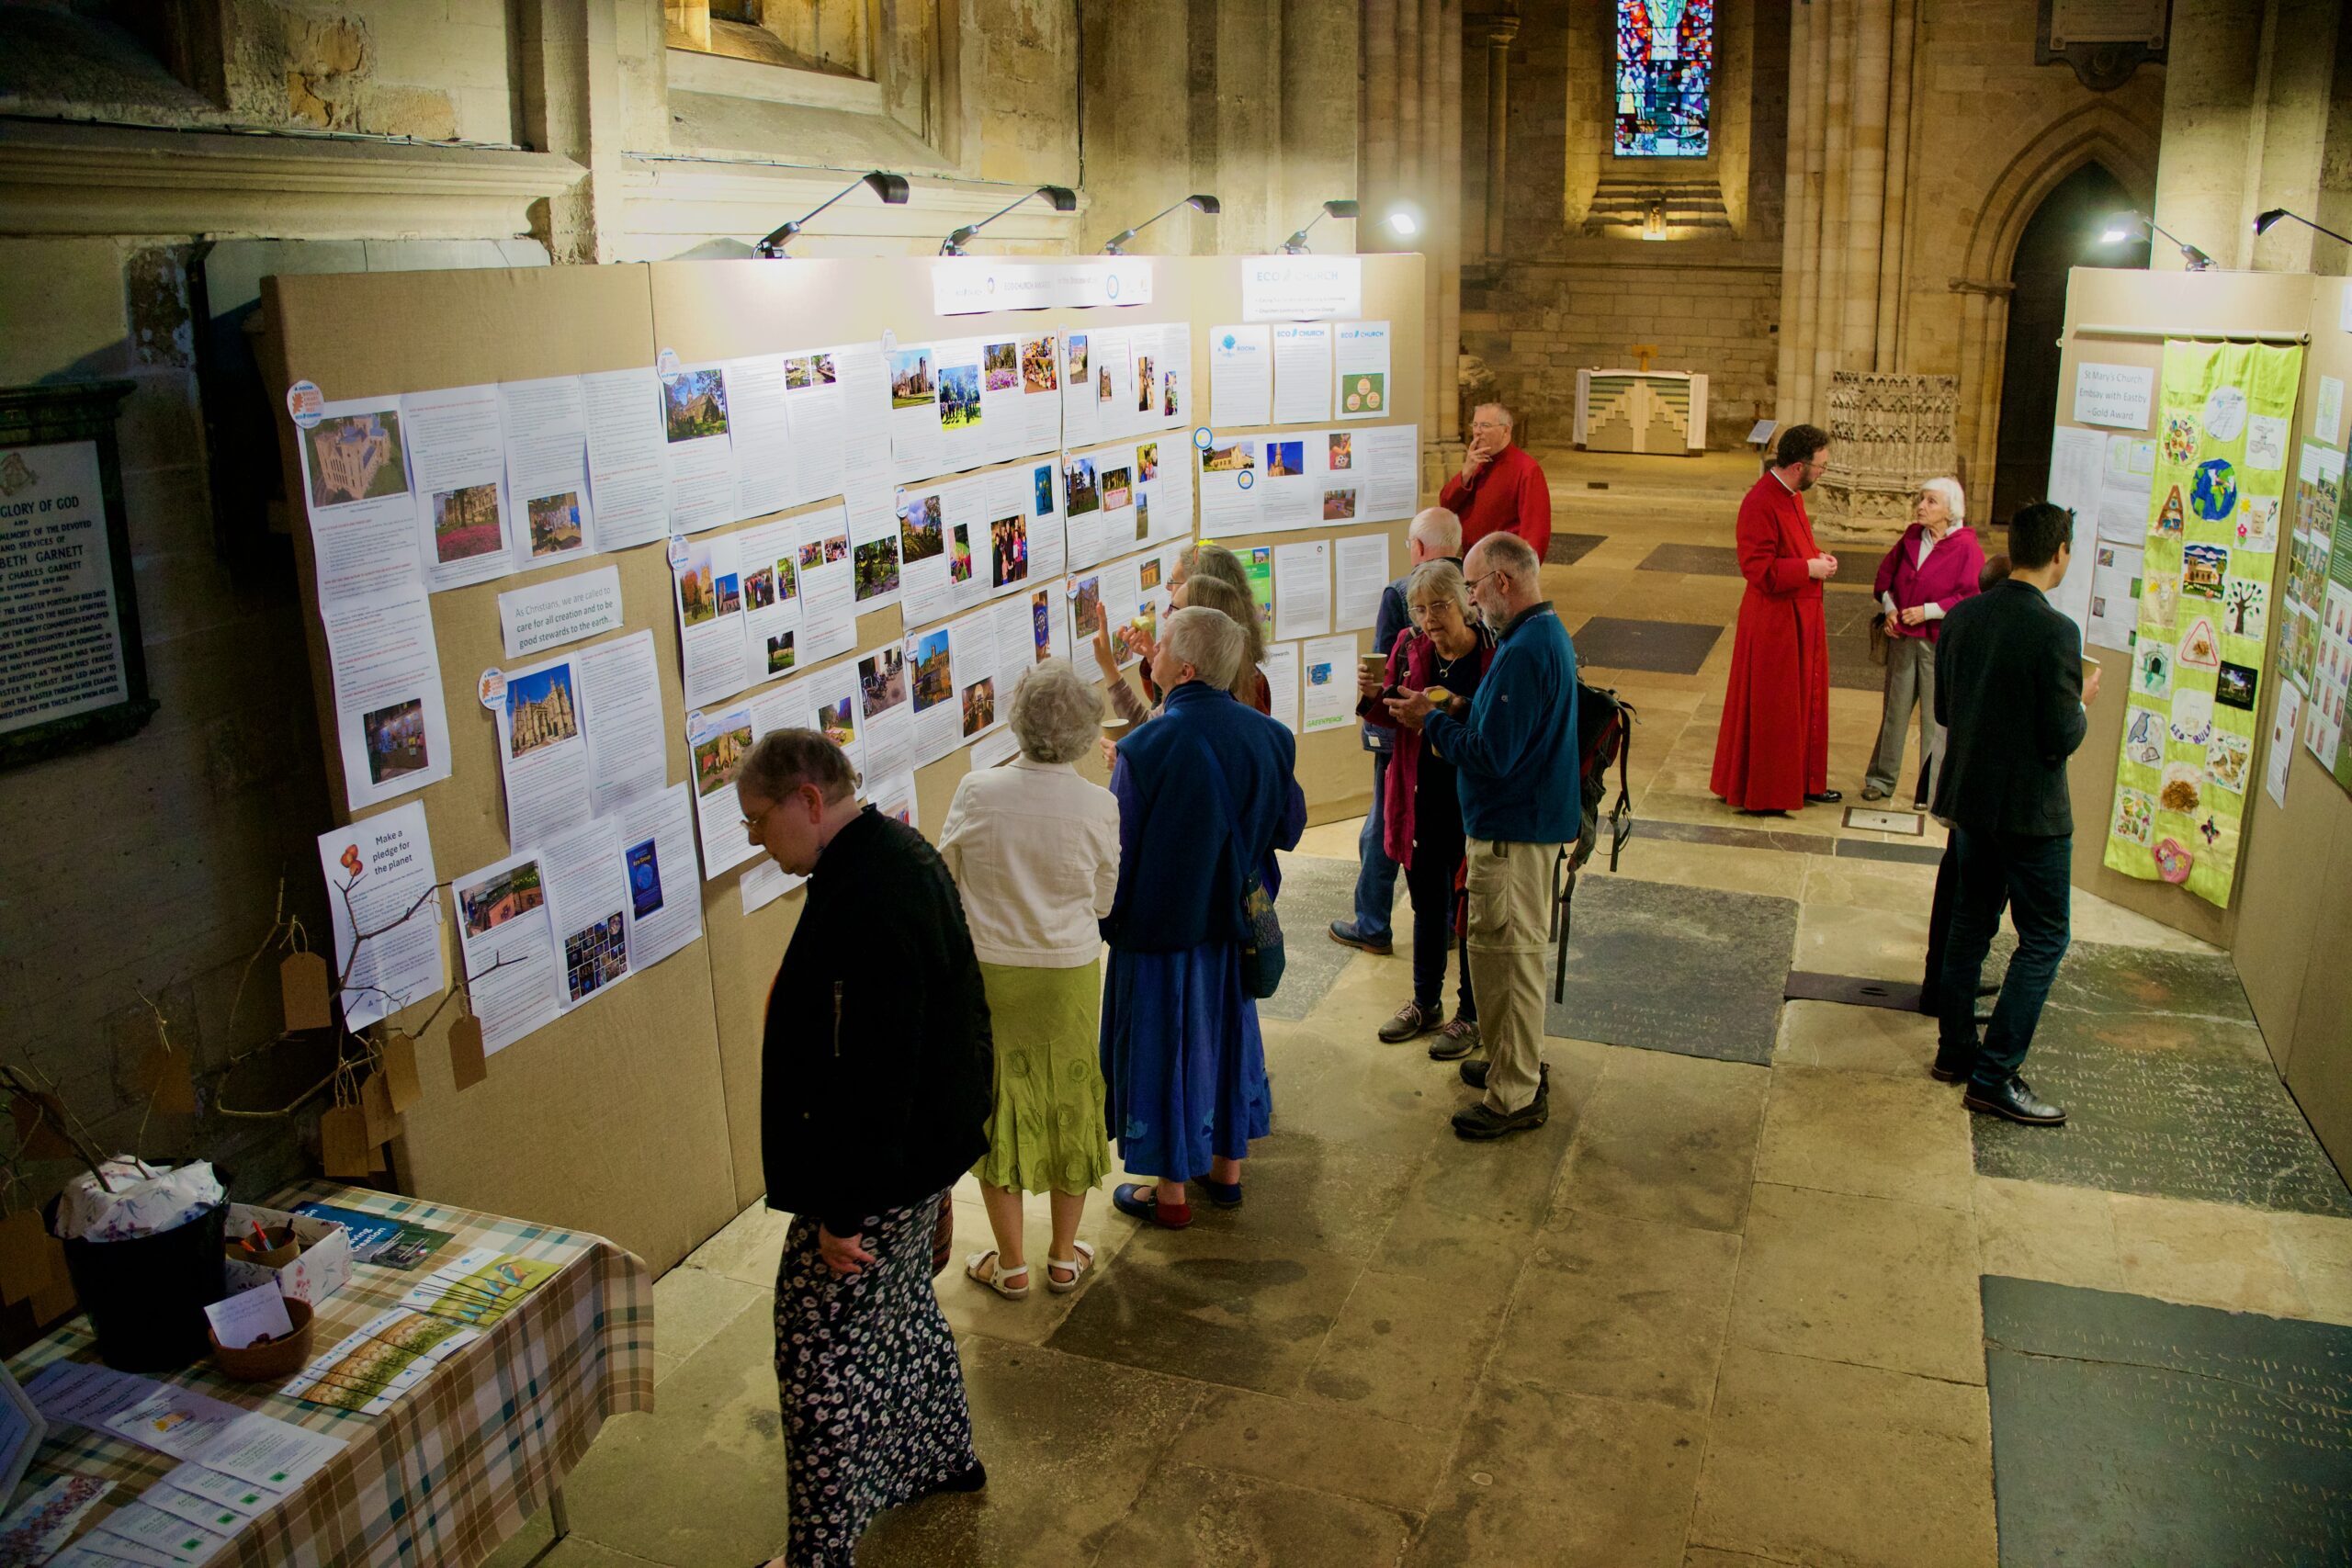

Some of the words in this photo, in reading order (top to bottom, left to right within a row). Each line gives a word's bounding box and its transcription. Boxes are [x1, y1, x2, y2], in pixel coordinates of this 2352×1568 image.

[1257, 271, 1279, 281] ECO
[1295, 271, 1339, 281] CHURCH
[2085, 370, 2091, 379] St
[2092, 371, 2115, 382] Mary's
[2117, 374, 2143, 383] Church
[2079, 388, 2103, 400] Embsay
[2106, 390, 2121, 400] with
[2123, 392, 2147, 404] Eastby
[2109, 410, 2133, 421] Award
[0, 502, 34, 518] GLORY
[40, 500, 51, 512] OF
[57, 496, 79, 510] GOD
[34, 527, 42, 536] OF
[46, 525, 59, 534] THE
[62, 520, 92, 532] DEVOTED
[0, 544, 16, 552] AND
[19, 538, 53, 549] SERVICES
[36, 545, 83, 563] GARNETT
[9, 568, 43, 581] CHARLES
[48, 561, 81, 573] GARNETT
[18, 603, 45, 613] GREATER
[47, 597, 72, 607] PORTION
[515, 608, 525, 618] As
[561, 596, 571, 605] we
[573, 594, 584, 604] are
[585, 589, 603, 600] called
[604, 586, 611, 594] to
[516, 622, 533, 633] care
[534, 619, 544, 629] for
[545, 615, 554, 625] all
[555, 607, 582, 623] creation
[583, 605, 596, 615] and
[596, 604, 605, 612] to
[605, 600, 614, 609] be
[519, 636, 538, 650] good
[538, 626, 570, 642] stewards
[571, 625, 579, 634] to
[579, 621, 591, 631] the
[24, 644, 68, 657] INSTRUMENTAL
[90, 644, 113, 654] WIDELY
[8, 671, 37, 683] BELOVED
[62, 674, 73, 682] SHE
[89, 666, 107, 676] MANY
[29, 691, 53, 701] MASTER
[53, 682, 80, 694] THROUGH
[1306, 715, 1344, 728] GREENPEACE
[376, 833, 397, 845] Make
[398, 830, 403, 839] a
[372, 845, 398, 863] pledge
[399, 840, 411, 852] for
[374, 862, 388, 875] the
[389, 854, 413, 871] planet
[350, 1228, 374, 1245] aving
